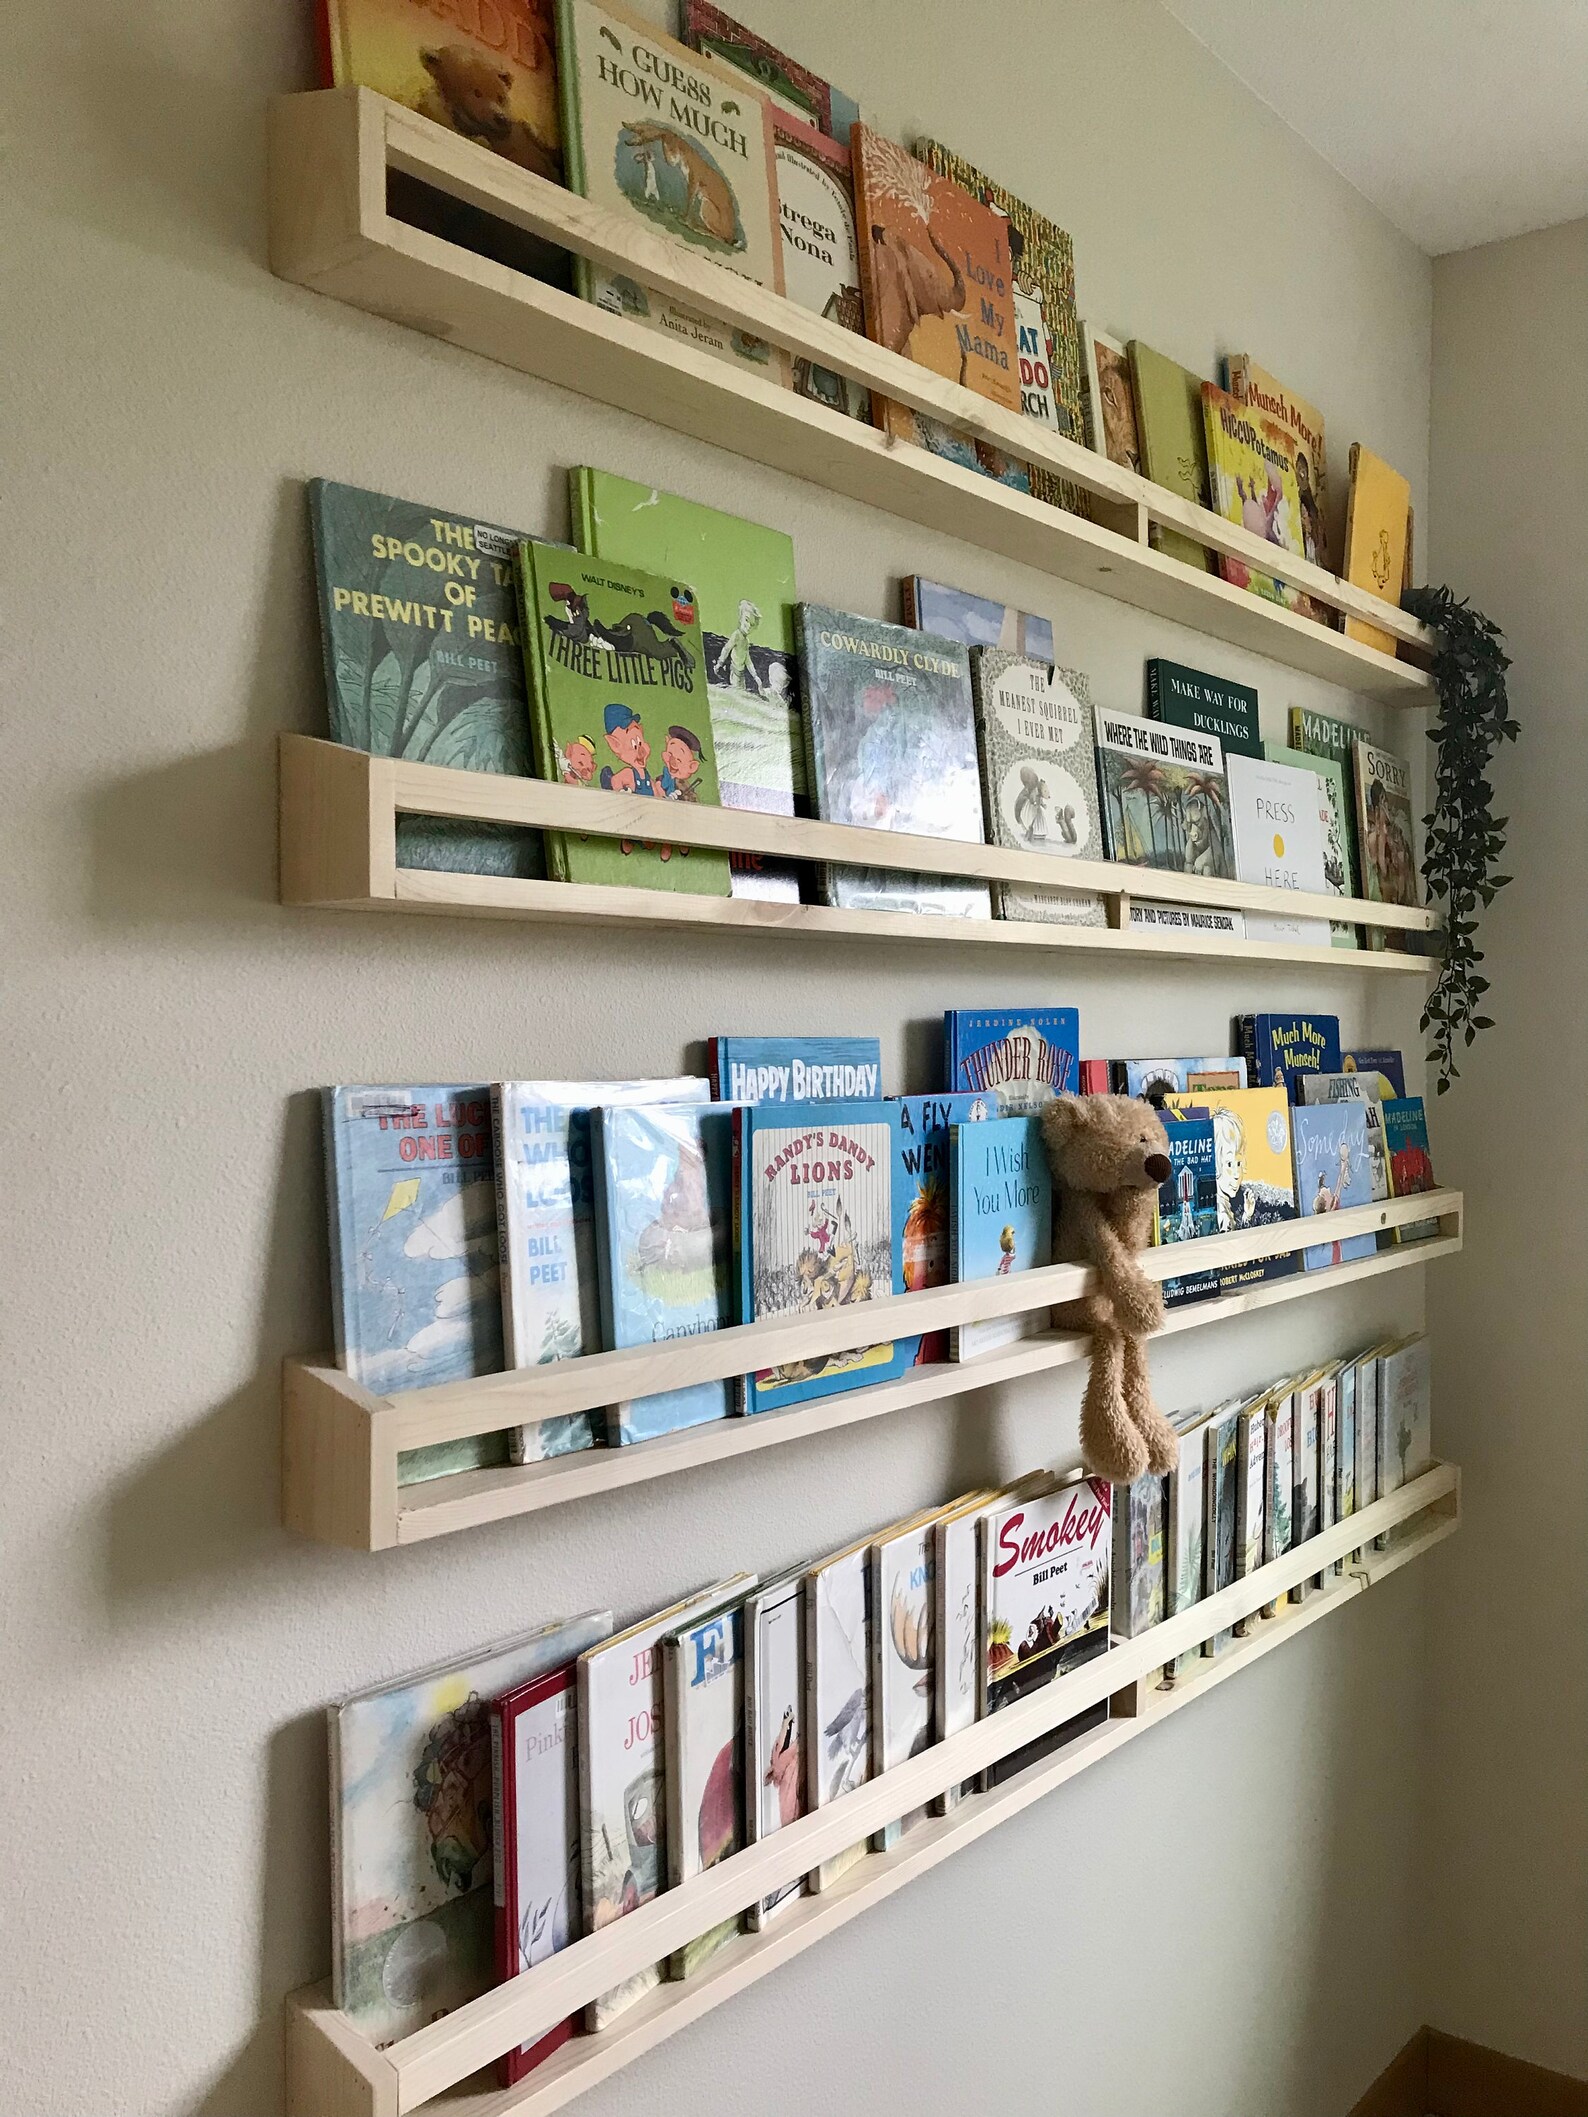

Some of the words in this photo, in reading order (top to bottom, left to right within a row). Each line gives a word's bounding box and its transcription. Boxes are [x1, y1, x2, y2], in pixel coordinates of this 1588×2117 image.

[632, 45, 711, 107] GUESS
[597, 55, 664, 110] HOW
[671, 97, 748, 160] MUCH
[780, 222, 834, 267] Nona
[994, 237, 1001, 263] I
[965, 251, 1005, 298] Love
[980, 297, 1005, 337] My
[659, 313, 688, 336] Anita
[690, 324, 724, 350] Jeram
[955, 323, 1009, 371] Mama
[1248, 381, 1288, 423] Munsch
[1290, 404, 1323, 460] More!
[430, 519, 474, 550] THE
[477, 530, 488, 539] NO
[478, 540, 512, 557] SEATTLE
[371, 533, 480, 580] SPOOKY
[444, 581, 476, 608] OF
[581, 573, 605, 587] WALT
[607, 580, 645, 598] DISNEY'S
[333, 586, 454, 633] PREWITT
[435, 651, 464, 667] BILL
[467, 656, 498, 674] PEET
[548, 630, 602, 680] THREE
[605, 650, 658, 686] LITTLE
[659, 655, 694, 694] PIGS
[820, 631, 910, 666] COWARDLY
[913, 653, 961, 679] CLYDE
[874, 668, 895, 682] BILL
[895, 673, 918, 687] PEET
[1029, 674, 1046, 693] THE
[1150, 668, 1159, 697] MAKE
[999, 690, 1036, 714] MEANEST
[1038, 700, 1078, 724] SQUIRREL
[1171, 678, 1201, 699] MAKE
[1203, 688, 1225, 707] WAY
[1227, 696, 1248, 714] FOR
[1024, 720, 1045, 740] EVER
[1047, 726, 1064, 744] MET
[1193, 713, 1250, 740] DUCKLINGS
[1104, 720, 1133, 748] WHERE
[1132, 728, 1149, 751] THE
[1150, 731, 1169, 756] WILD
[1169, 737, 1198, 763] THINGS
[1198, 745, 1214, 766] ARE
[1367, 751, 1406, 788] SORRY
[1256, 797, 1296, 825] PRESS
[1265, 866, 1300, 890] HERE
[1144, 908, 1156, 924] AND
[1157, 909, 1182, 927] PICTURES
[1183, 914, 1190, 928] BY
[1191, 914, 1213, 930] MAURICE
[1213, 916, 1234, 931] SENDAK
[1030, 1017, 1066, 1026] NOLEN
[1243, 1025, 1253, 1050] Much
[1272, 1021, 1300, 1051] Much
[1301, 1021, 1327, 1050] More
[960, 1036, 1032, 1092] THUNDER
[1035, 1038, 1074, 1092] ROSE
[1284, 1048, 1321, 1071] Munsch!
[731, 1063, 791, 1102] HAPPY
[792, 1059, 878, 1101] BIRTHDAY
[1327, 1076, 1361, 1099] FISHING
[379, 1103, 429, 1131] THE
[491, 1097, 499, 1115] THE
[521, 1105, 565, 1135] THE
[901, 1103, 915, 1136] A
[922, 1100, 952, 1134] FLY
[1017, 1102, 1044, 1112] NELSO
[1384, 1110, 1424, 1124] MADELINE
[399, 1135, 453, 1163] ONE
[458, 1134, 487, 1159] OF
[492, 1117, 503, 1168] CABOOSE
[1297, 1110, 1370, 1166] Someday
[523, 1139, 590, 1168] WHO
[764, 1131, 824, 1183] RANDY'S
[828, 1131, 876, 1173] DANDY
[985, 1146, 990, 1177] I
[993, 1141, 1030, 1176] Wish
[1173, 1157, 1185, 1167] THE
[1186, 1155, 1199, 1165] BAD
[1200, 1154, 1212, 1164] HAT
[442, 1172, 469, 1185] BILL
[495, 1171, 505, 1199] WHO
[790, 1159, 854, 1185] LIONS
[807, 1189, 821, 1199] BILL
[821, 1187, 836, 1198] PEET
[973, 1186, 1000, 1216] You
[1004, 1178, 1041, 1211] More
[498, 1203, 506, 1226] GOT
[499, 1230, 508, 1264] LOOSE
[528, 1234, 562, 1258] BILL
[530, 1260, 567, 1286] PEET
[1238, 1268, 1265, 1282] McCLOSKEY
[1163, 1286, 1185, 1300] LUDWIG
[1185, 1279, 1219, 1295] BEMELMANS
[992, 1492, 1105, 1578] Smokey
[1033, 1567, 1049, 1586] Bill
[1050, 1562, 1068, 1579] Peet
